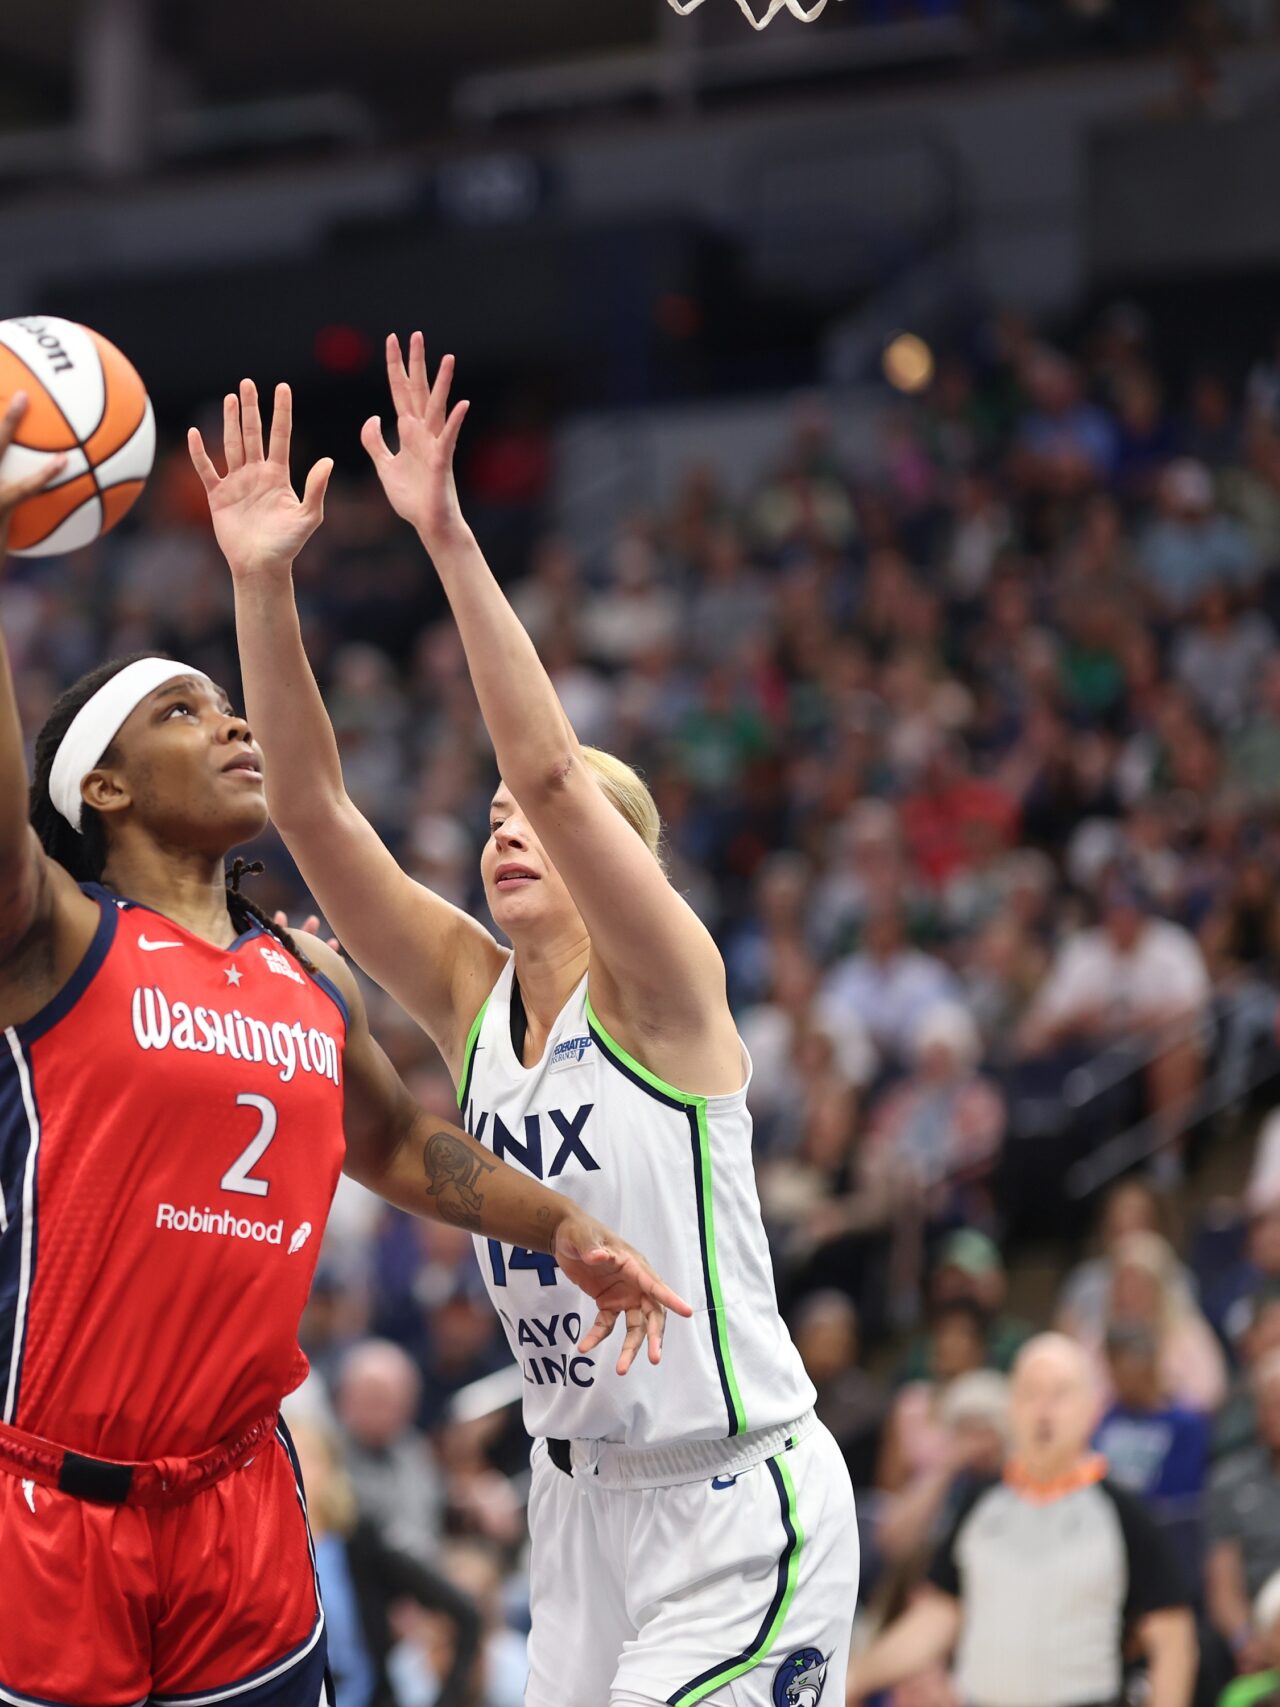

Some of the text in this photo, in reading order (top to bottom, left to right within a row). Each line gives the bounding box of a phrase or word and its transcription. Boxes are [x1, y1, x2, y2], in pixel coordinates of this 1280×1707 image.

[132, 986, 340, 1086] Washington
[220, 1092, 278, 1196] 2
[156, 1203, 284, 1245] Robinhood
[499, 1308, 581, 1347] AYO
